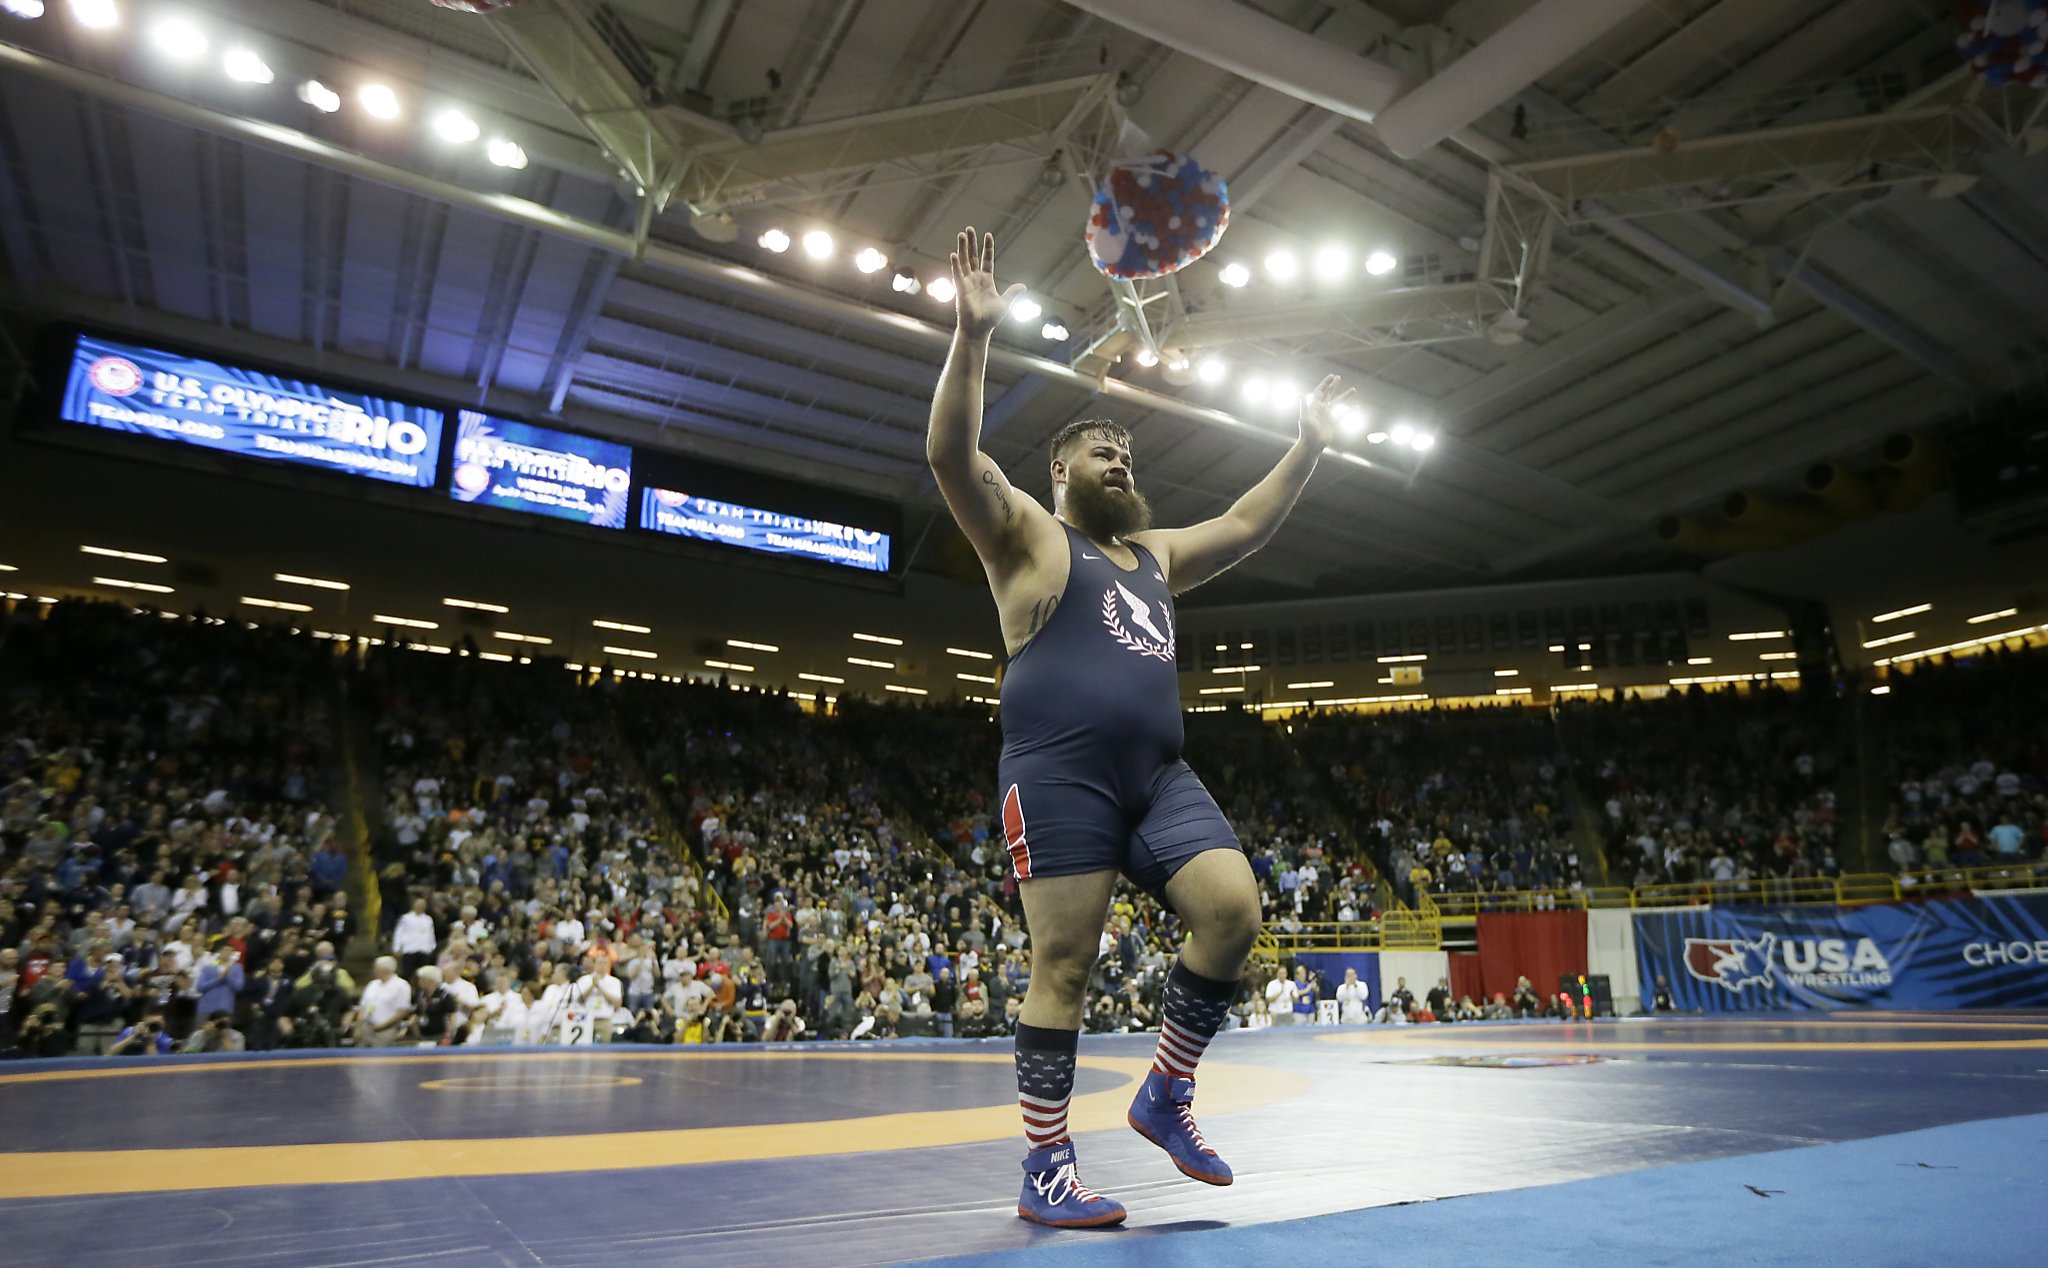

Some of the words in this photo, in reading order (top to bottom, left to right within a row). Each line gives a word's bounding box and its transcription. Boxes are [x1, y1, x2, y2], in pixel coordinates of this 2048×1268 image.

[152, 389, 226, 416] TEAM
[211, 384, 330, 423] OLYMPIC
[343, 410, 428, 455] RIO
[575, 459, 631, 493] RIO
[657, 511, 746, 539] TEAMUSA.ORG
[696, 499, 744, 520] TEAM
[752, 510, 812, 533] TRIALS
[766, 533, 877, 563] TEAMUSASHOP.COM
[1782, 937, 1889, 973] USA
[1786, 970, 1892, 988] WRESTLING
[571, 1026, 583, 1045] 2
[1050, 1148, 1070, 1164] NIKE
